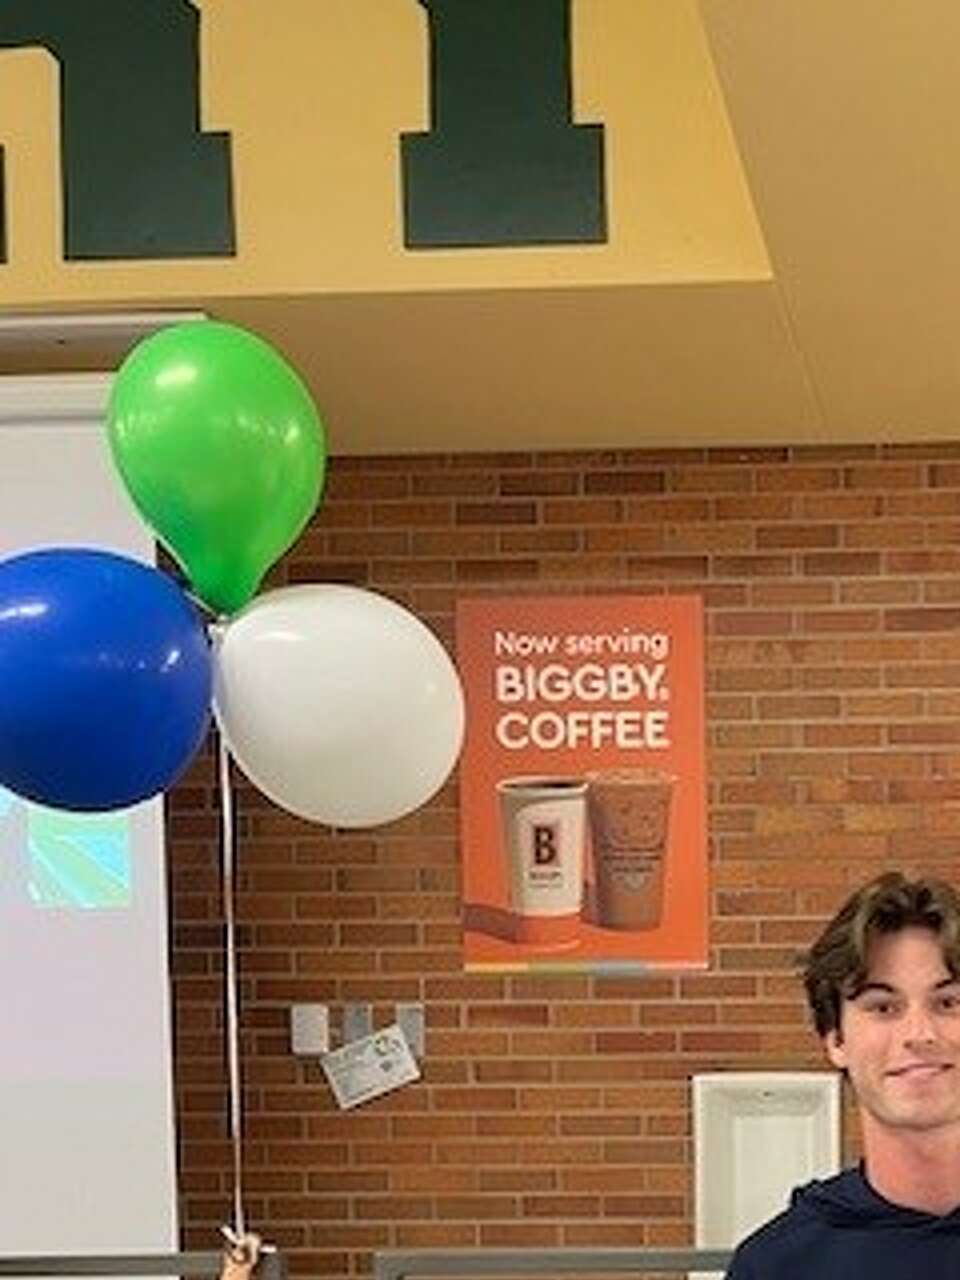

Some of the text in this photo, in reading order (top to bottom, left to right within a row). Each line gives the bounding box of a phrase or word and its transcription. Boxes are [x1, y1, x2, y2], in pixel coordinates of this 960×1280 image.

[495, 627, 669, 661] Now serving
[496, 711, 671, 749] COFFEE
[534, 827, 556, 865] B
